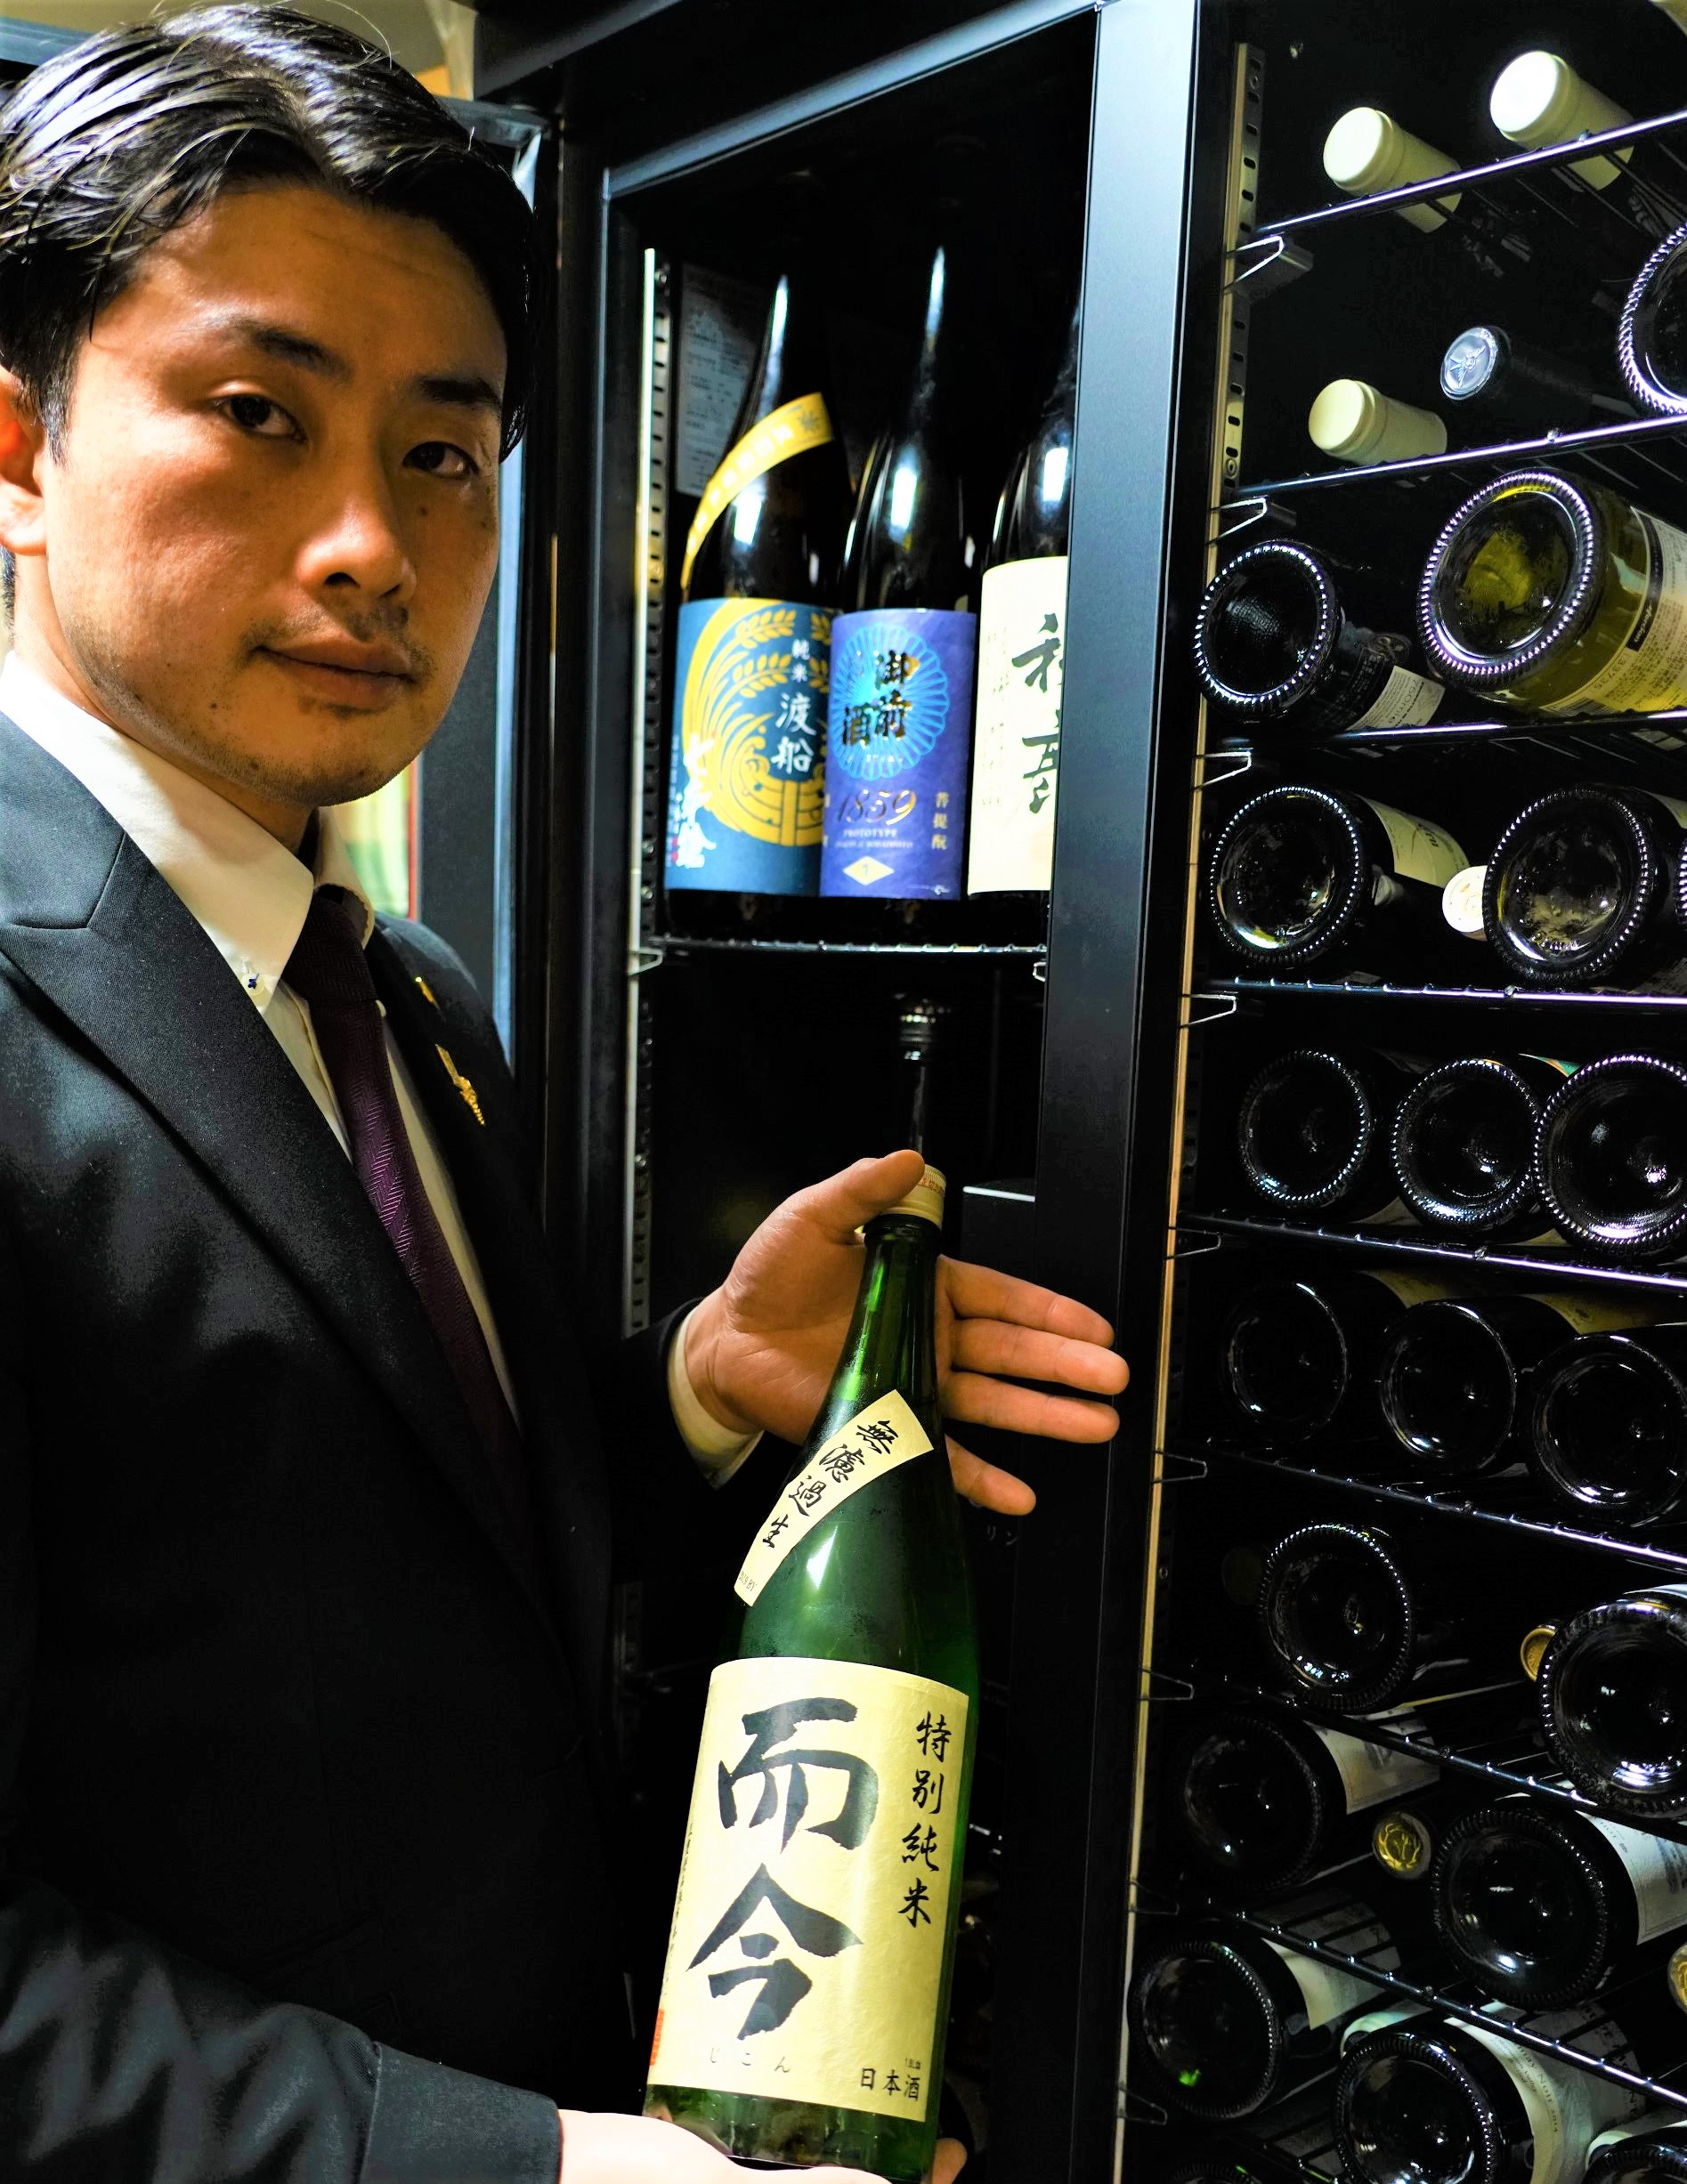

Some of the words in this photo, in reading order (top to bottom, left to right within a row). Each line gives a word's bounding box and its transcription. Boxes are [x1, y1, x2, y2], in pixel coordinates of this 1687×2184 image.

[837, 789, 917, 826] 1859
[685, 1695, 880, 2042] 而今
[897, 1709, 953, 1929] 特別純米
[860, 2067, 921, 2102] 日本酒
